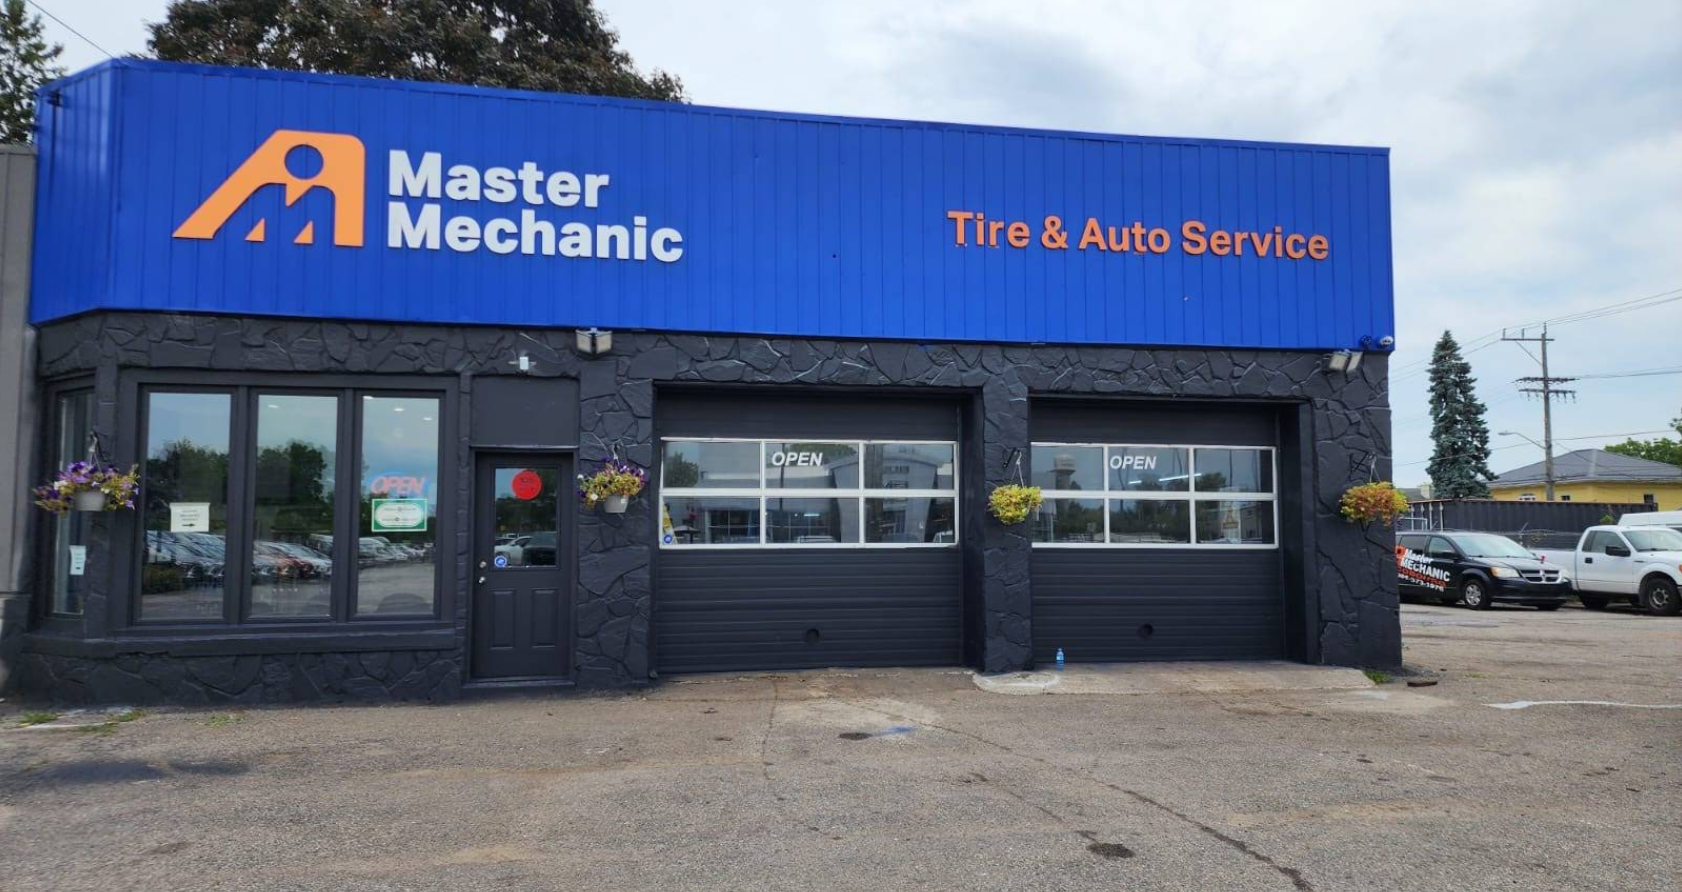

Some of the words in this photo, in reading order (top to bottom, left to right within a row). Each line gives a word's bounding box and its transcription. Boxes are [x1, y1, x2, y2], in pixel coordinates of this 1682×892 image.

[389, 149, 610, 208] Master
[387, 201, 684, 263] Mechanic
[947, 210, 1030, 248] Tire
[1040, 215, 1068, 249] &
[1078, 217, 1171, 254] Auto
[1182, 220, 1330, 260] Service
[771, 451, 824, 467] OPEN
[1109, 455, 1158, 471] OPEN
[369, 476, 425, 495] OPEN
[1404, 548, 1434, 564] Master
[1400, 557, 1451, 582] MECHANIC
